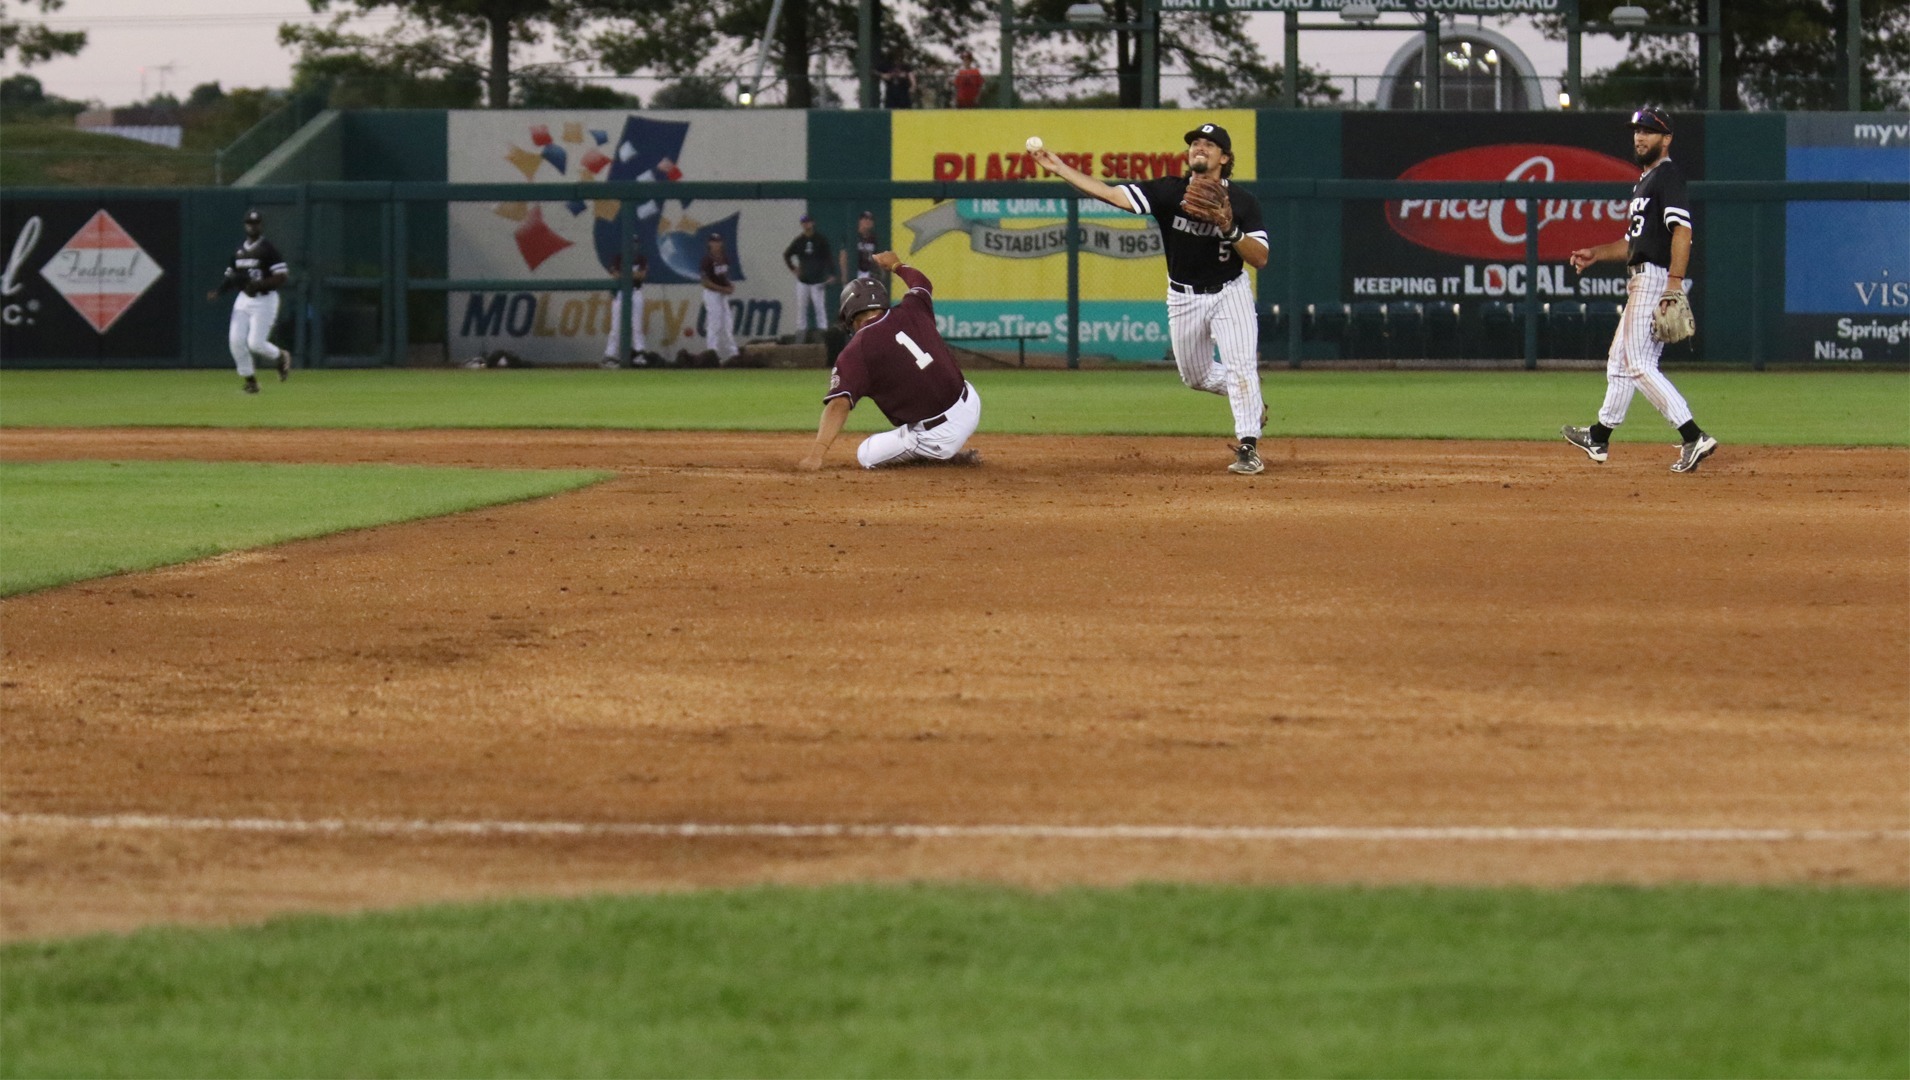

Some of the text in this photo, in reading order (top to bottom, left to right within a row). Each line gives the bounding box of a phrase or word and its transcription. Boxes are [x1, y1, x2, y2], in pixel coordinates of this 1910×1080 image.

[1416, 0, 1558, 9] SCOREBOARD
[1201, 125, 1214, 133] D
[1854, 124, 1910, 146] myv
[934, 152, 1038, 181] PLAZA
[1101, 152, 1190, 180] SERVIC
[1400, 156, 1632, 244] PriceCutte
[1172, 215, 1225, 239] DRUR
[985, 228, 1161, 253] ESTABLISHD IN 1963
[1218, 240, 1231, 262] 5
[57, 250, 140, 277] Federal
[1353, 264, 1630, 296] KEEPING IT LOCAL SINC
[1854, 269, 1910, 307] vis
[1837, 317, 1910, 344] Springf
[895, 330, 934, 370] 1
[1814, 341, 1863, 359] Nixa
